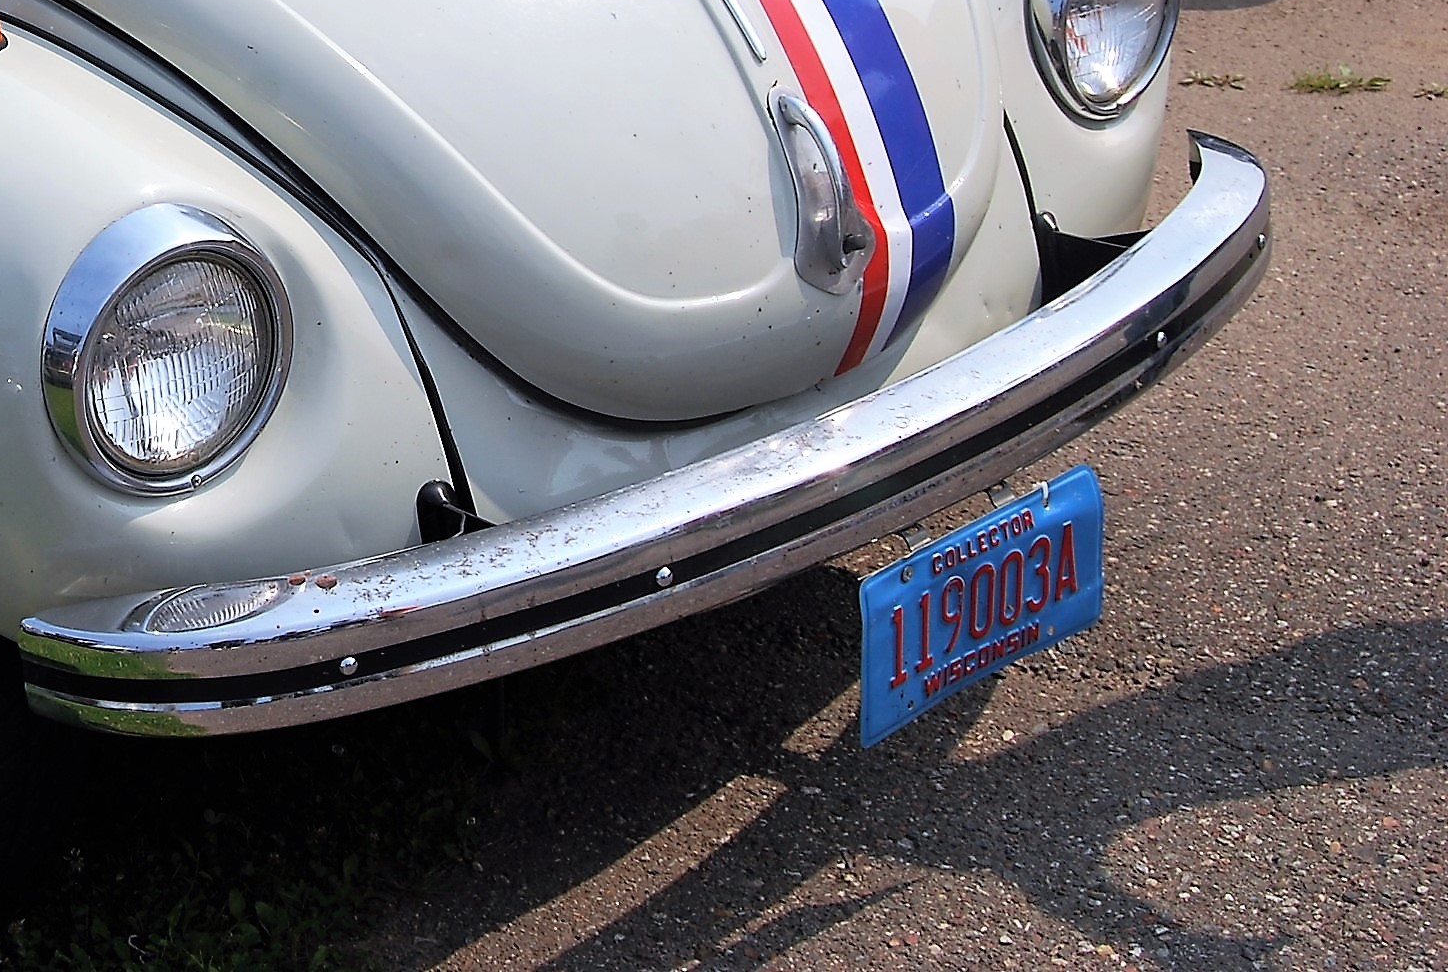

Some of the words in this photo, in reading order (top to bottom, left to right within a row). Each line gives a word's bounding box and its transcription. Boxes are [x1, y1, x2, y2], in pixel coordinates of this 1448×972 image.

[932, 509, 1035, 574] COLLECTOR
[890, 520, 1078, 689] 119003A
[923, 619, 1041, 698] WISCONSIN
